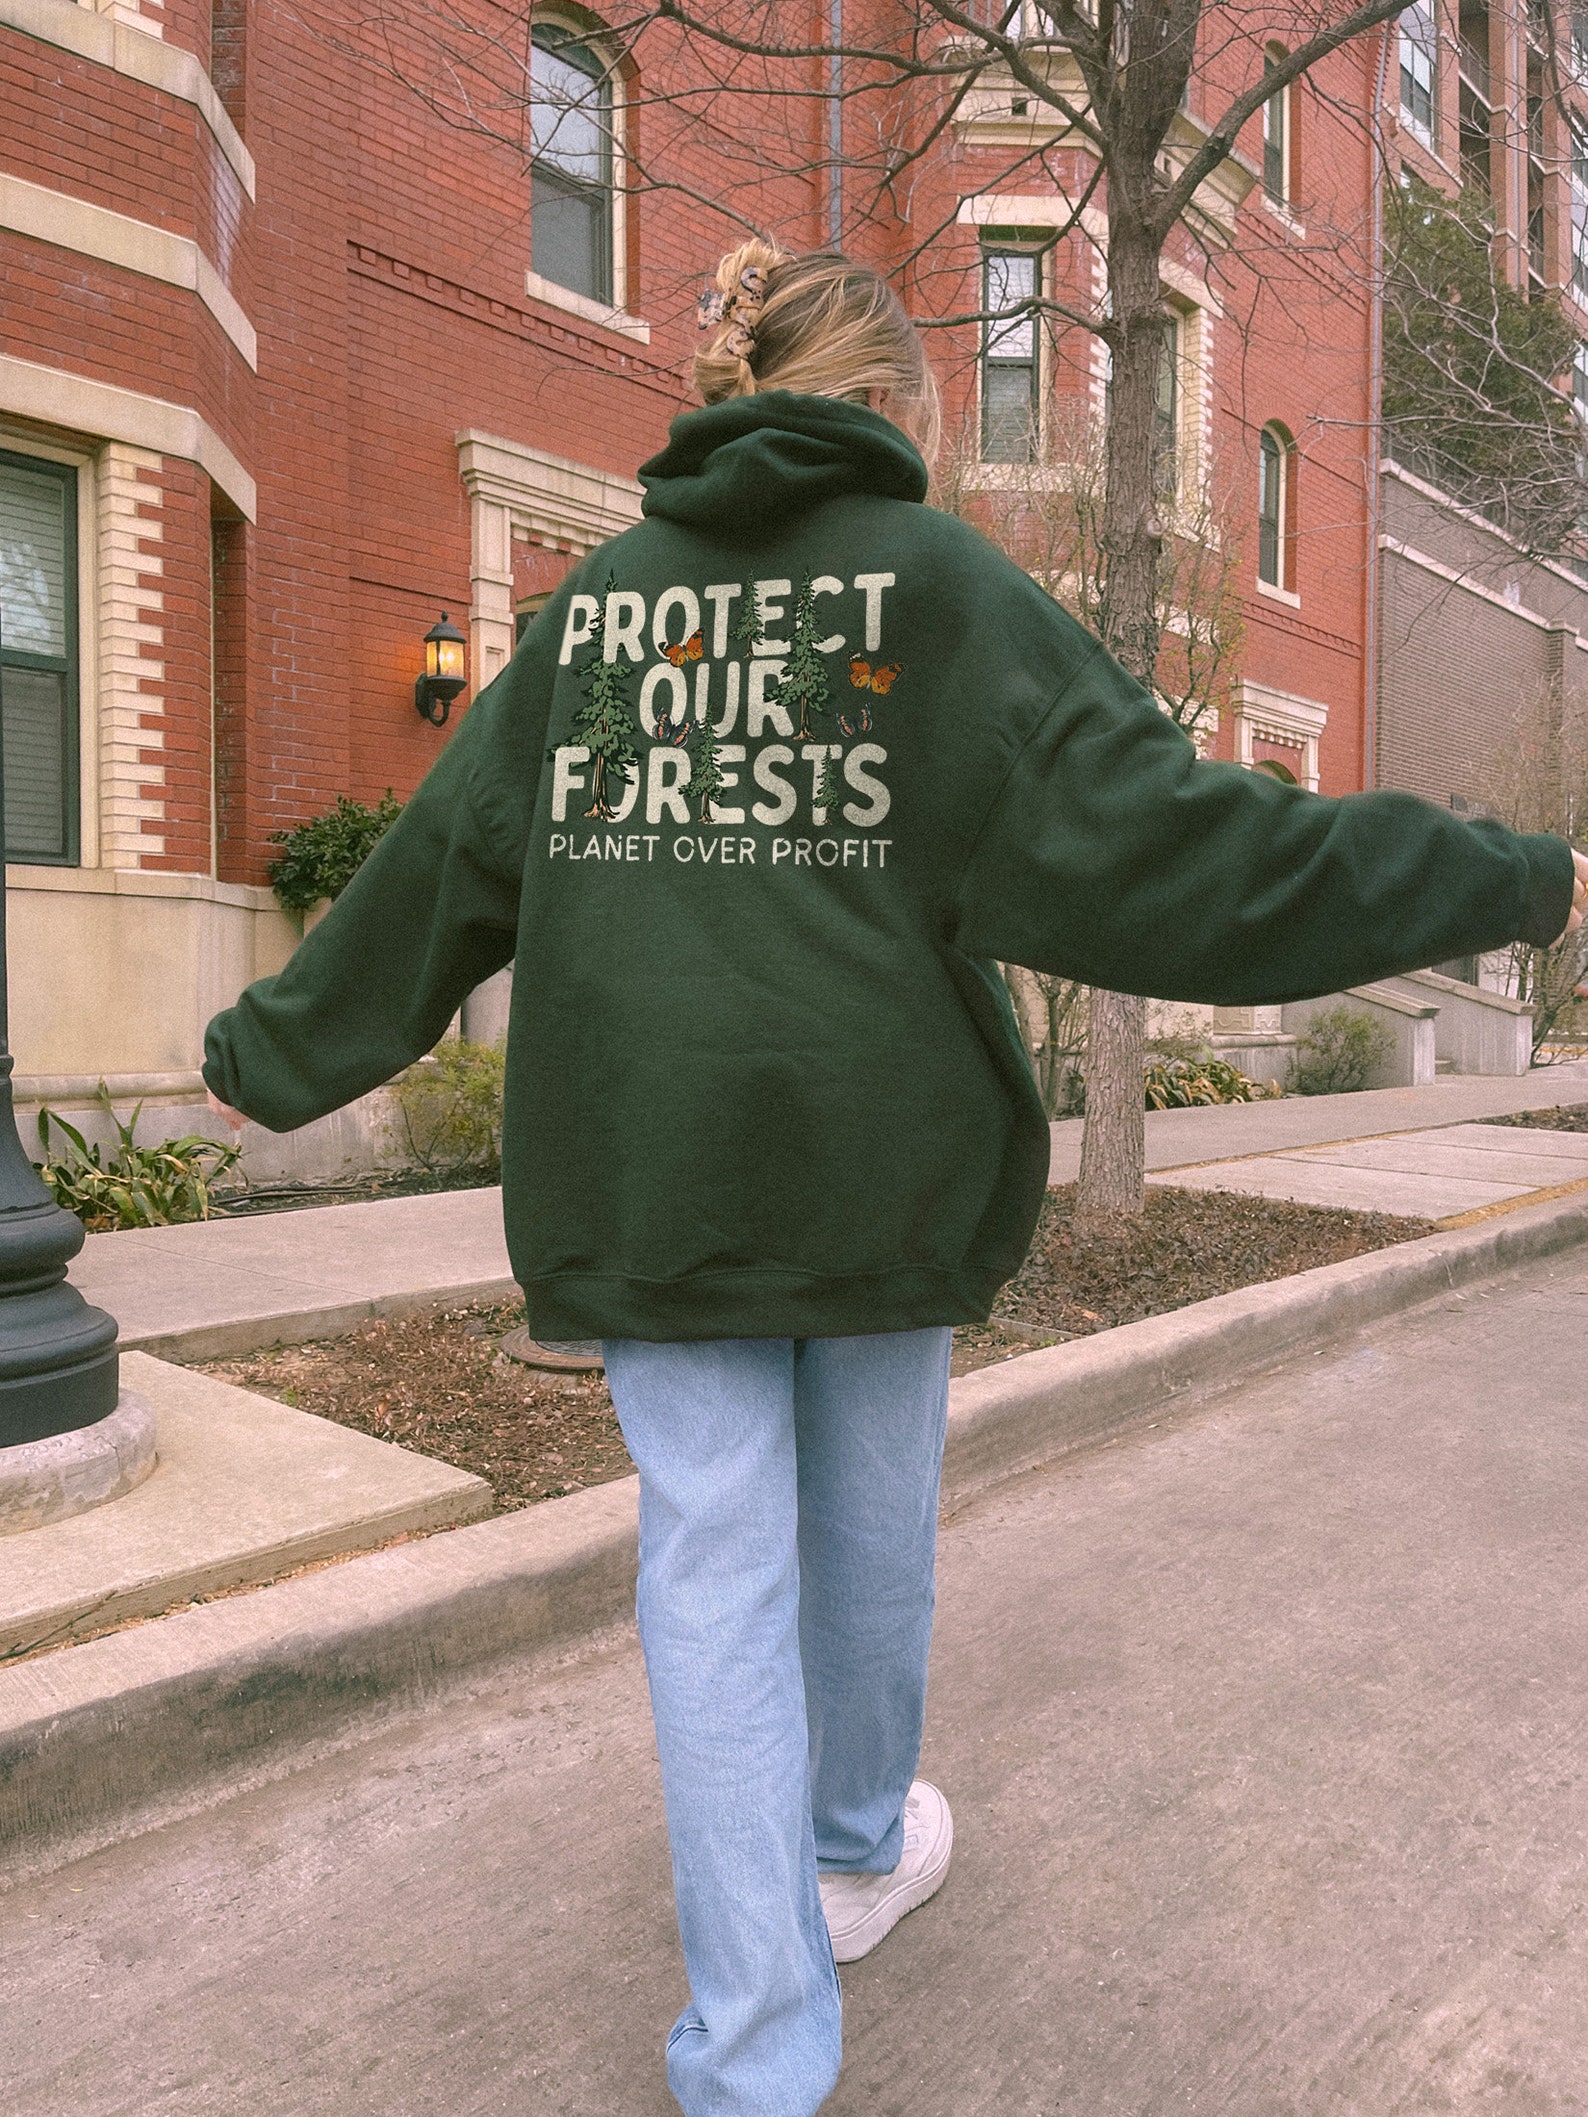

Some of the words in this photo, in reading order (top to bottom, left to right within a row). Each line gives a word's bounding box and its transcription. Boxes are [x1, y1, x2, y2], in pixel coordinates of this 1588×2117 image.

[559, 573, 896, 665] PROTECT
[639, 659, 795, 738] OUR
[551, 743, 891, 827] FORESTS
[549, 833, 660, 861] PLANET
[673, 836, 756, 865] OVER
[772, 837, 893, 868] PROFIT
